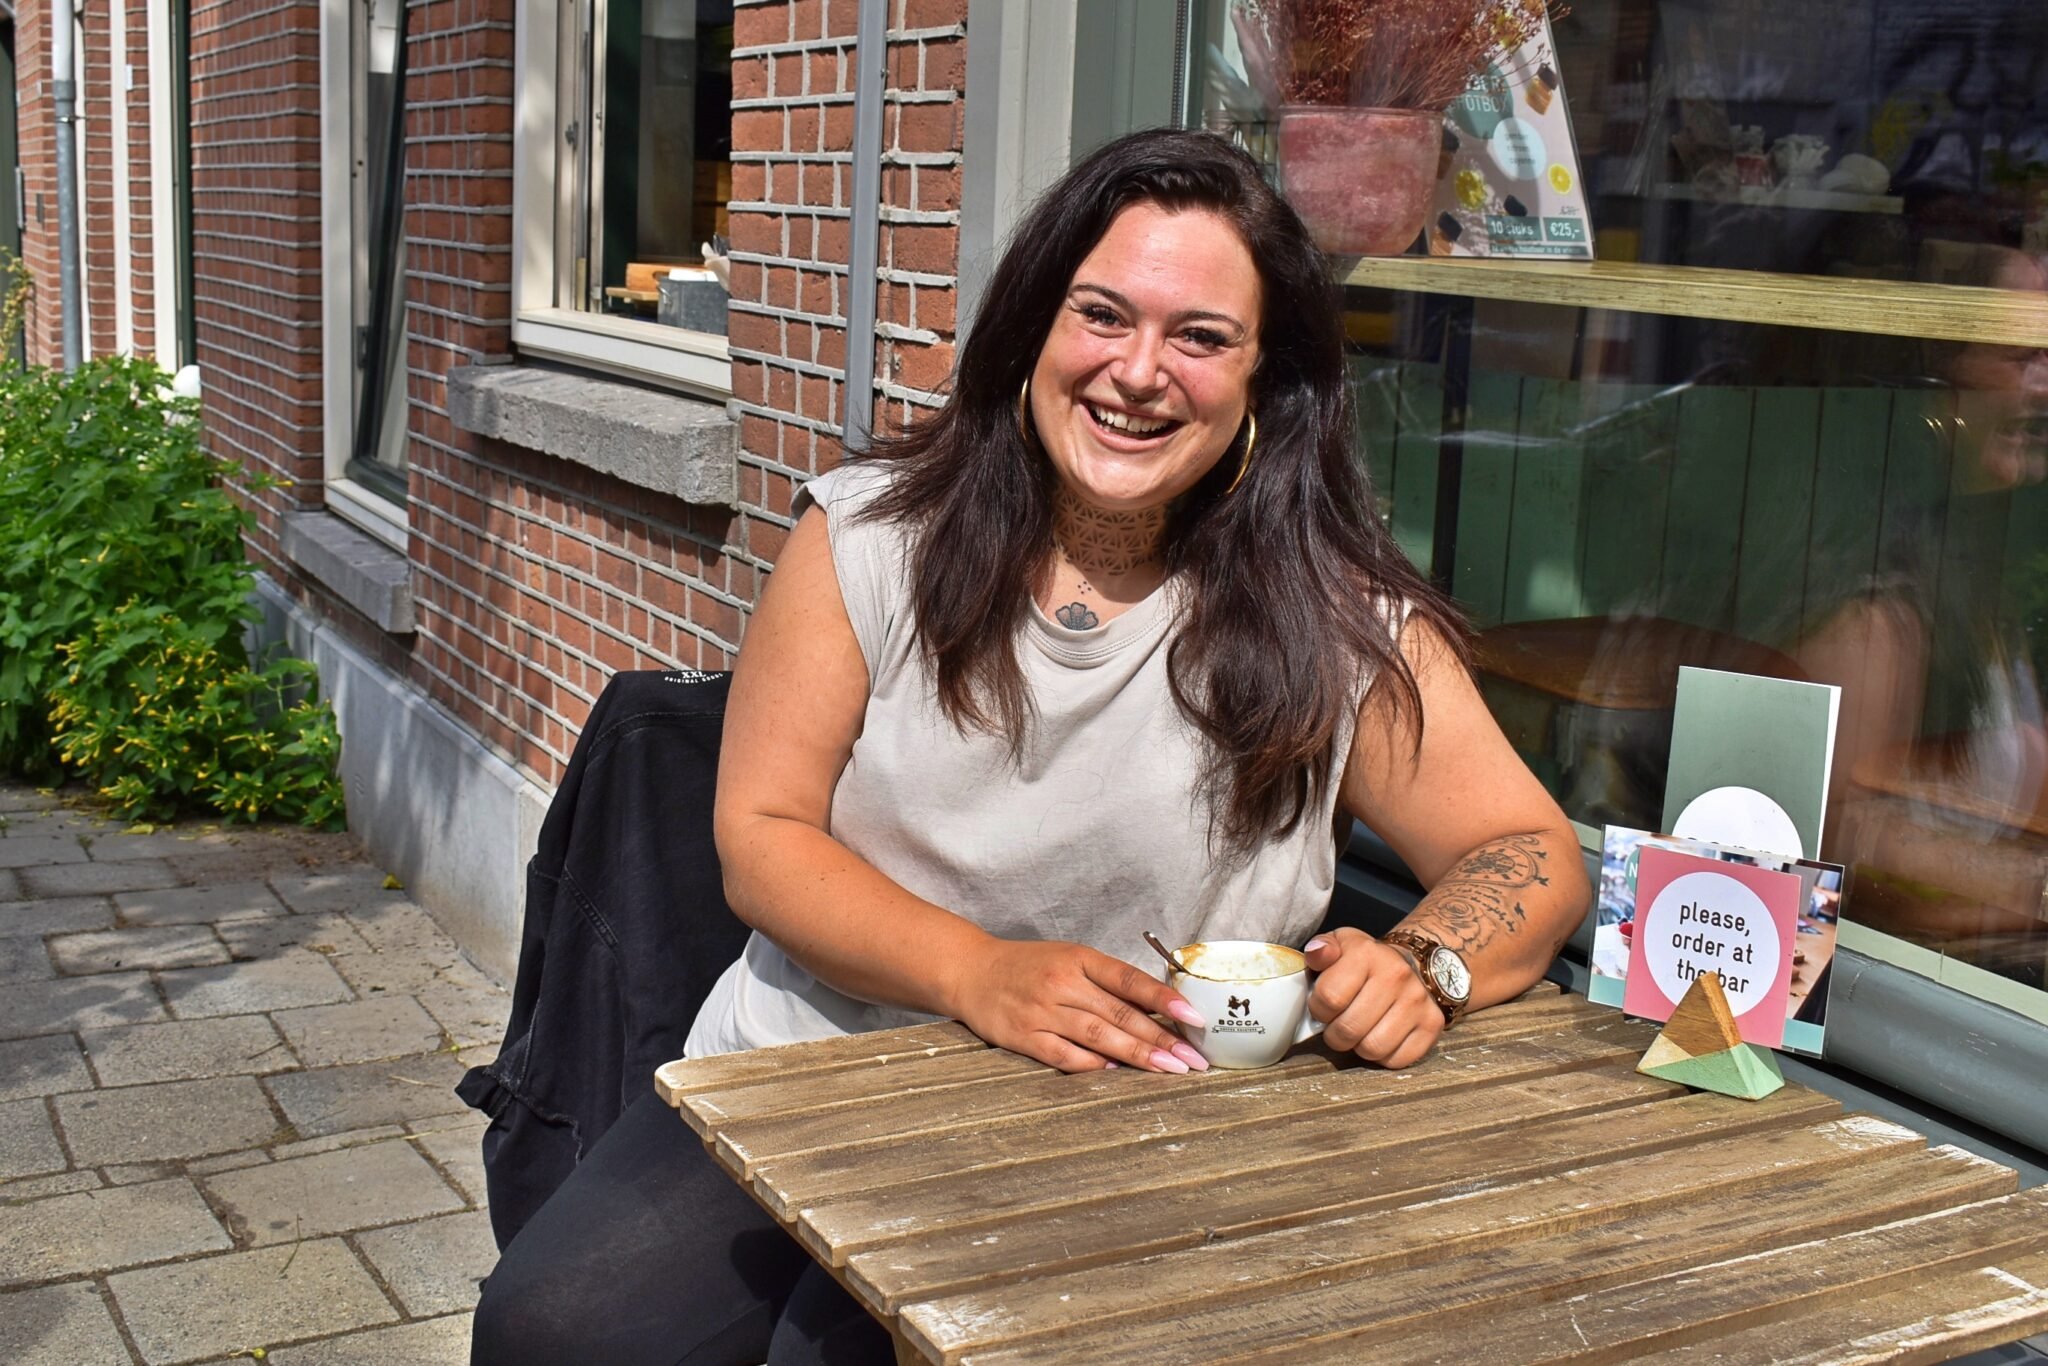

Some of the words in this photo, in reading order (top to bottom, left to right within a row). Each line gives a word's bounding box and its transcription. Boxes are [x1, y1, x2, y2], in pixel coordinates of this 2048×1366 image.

[1491, 221, 1503, 234] 10
[1550, 222, 1580, 239] €25,-
[1679, 902, 1750, 936] please,
[1672, 933, 1725, 957] order
[1732, 944, 1753, 965] at
[1717, 968, 1749, 994] bar
